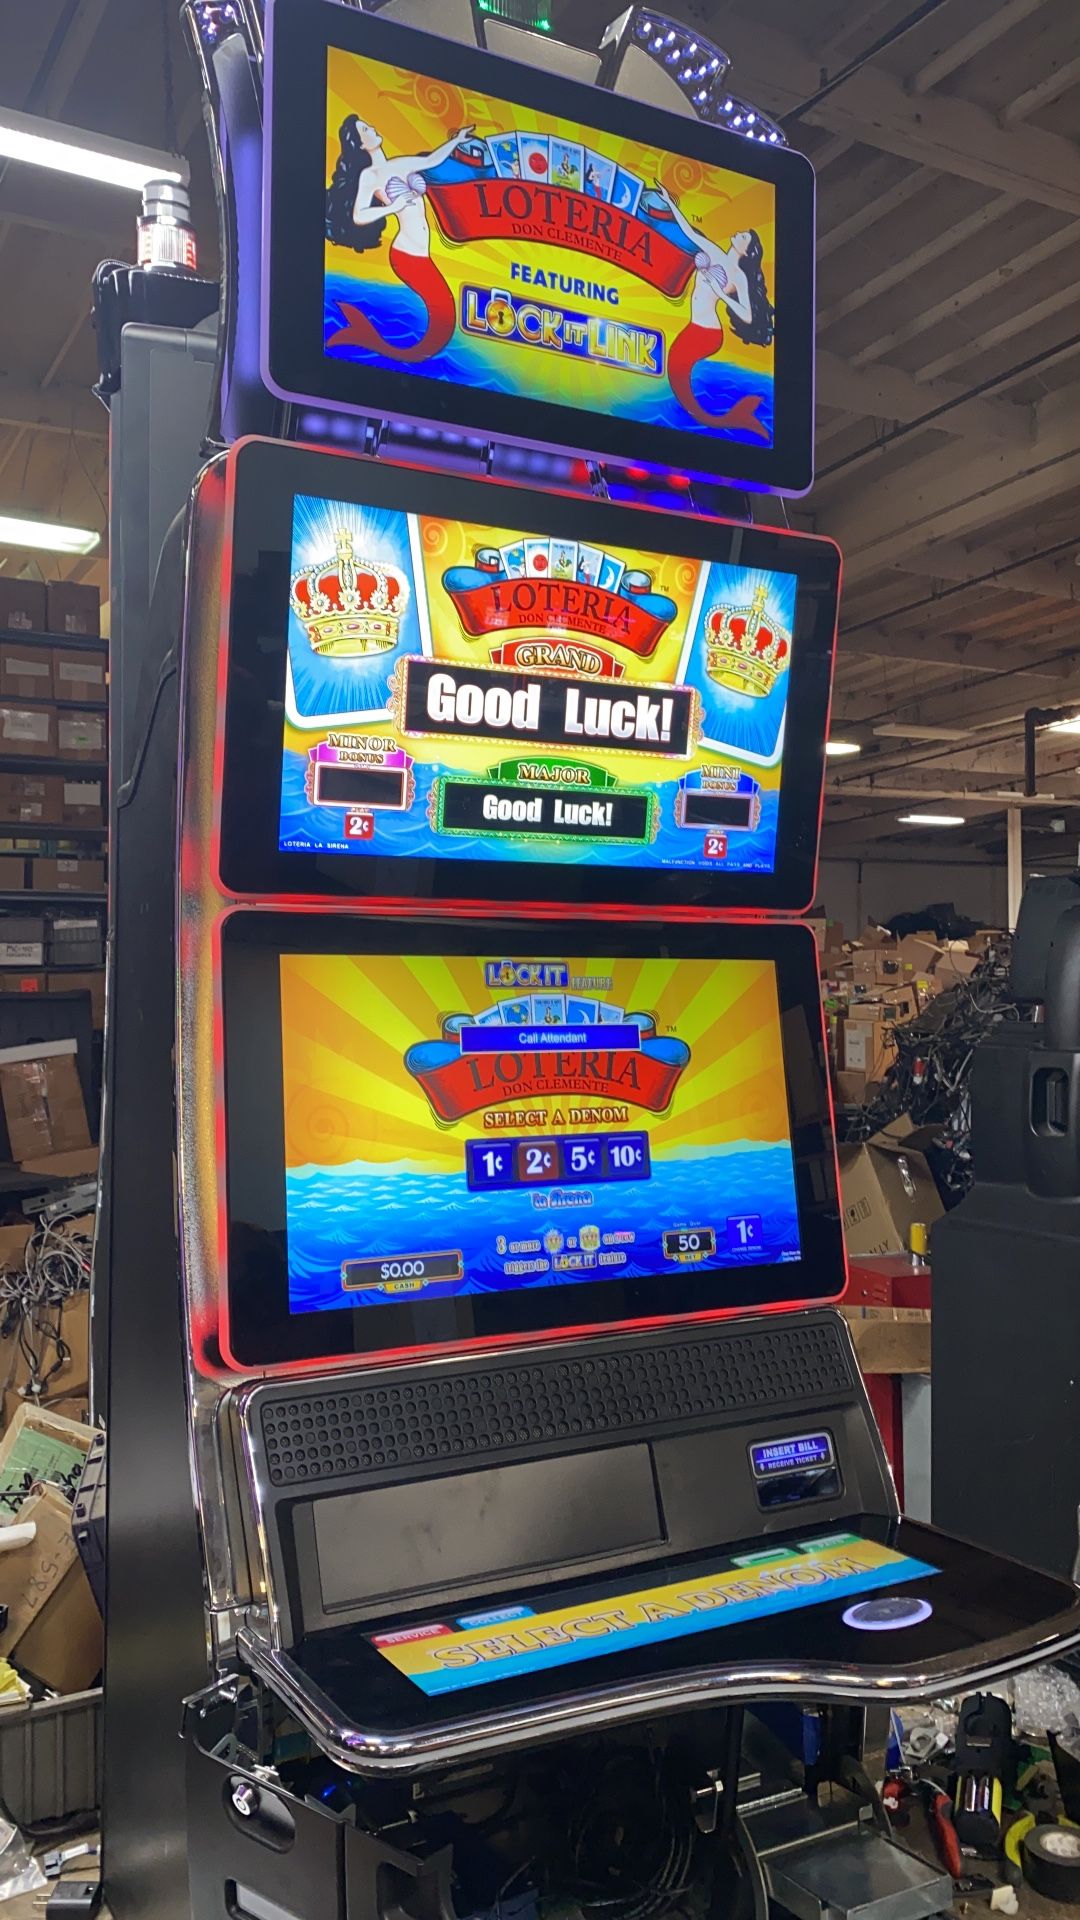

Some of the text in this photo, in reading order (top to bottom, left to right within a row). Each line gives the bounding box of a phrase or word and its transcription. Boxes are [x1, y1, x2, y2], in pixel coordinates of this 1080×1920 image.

[475, 183, 654, 268] LOTERIA
[512, 223, 623, 262] DON CLEMENTE
[510, 262, 619, 306] FEATURING
[466, 288, 658, 371] LOCK IT LINK
[491, 583, 631, 634] LOTERIA
[519, 613, 607, 634] DON CLEMENTE
[516, 645, 602, 674] GRAND
[426, 673, 675, 743] Good Luck!
[328, 733, 397, 752] MINOR
[339, 751, 384, 763] BONUS
[518, 764, 591, 784] MAJOR
[702, 764, 741, 780] MINI
[702, 780, 737, 791] BONUS
[482, 794, 614, 828] Good Luck!
[349, 816, 370, 836] 2¢
[283, 840, 311, 848] LOTERIA
[707, 838, 724, 855] 2¢
[488, 961, 541, 987] LOCK
[543, 964, 566, 987] IT
[519, 1032, 587, 1044] Call Attendant
[466, 1052, 641, 1092] LOTERIA
[503, 1078, 609, 1097] DON CLEMENTE
[484, 1107, 628, 1127] SELECT A DENOM
[482, 1151, 503, 1177] 1¢
[526, 1148, 551, 1174] 2¢
[570, 1146, 595, 1171] 5¢
[611, 1145, 642, 1167] 10¢
[736, 1220, 754, 1244] 1¢
[678, 1234, 700, 1251] 50
[381, 1261, 424, 1279] $0.00
[763, 1441, 819, 1459] INSERT BILL
[768, 1454, 817, 1470] RECEIVE TICKET
[434, 1557, 876, 1668] SELECT A DENOM
[469, 1611, 523, 1625] COLLECT
[387, 1629, 441, 1644] SERVICE
